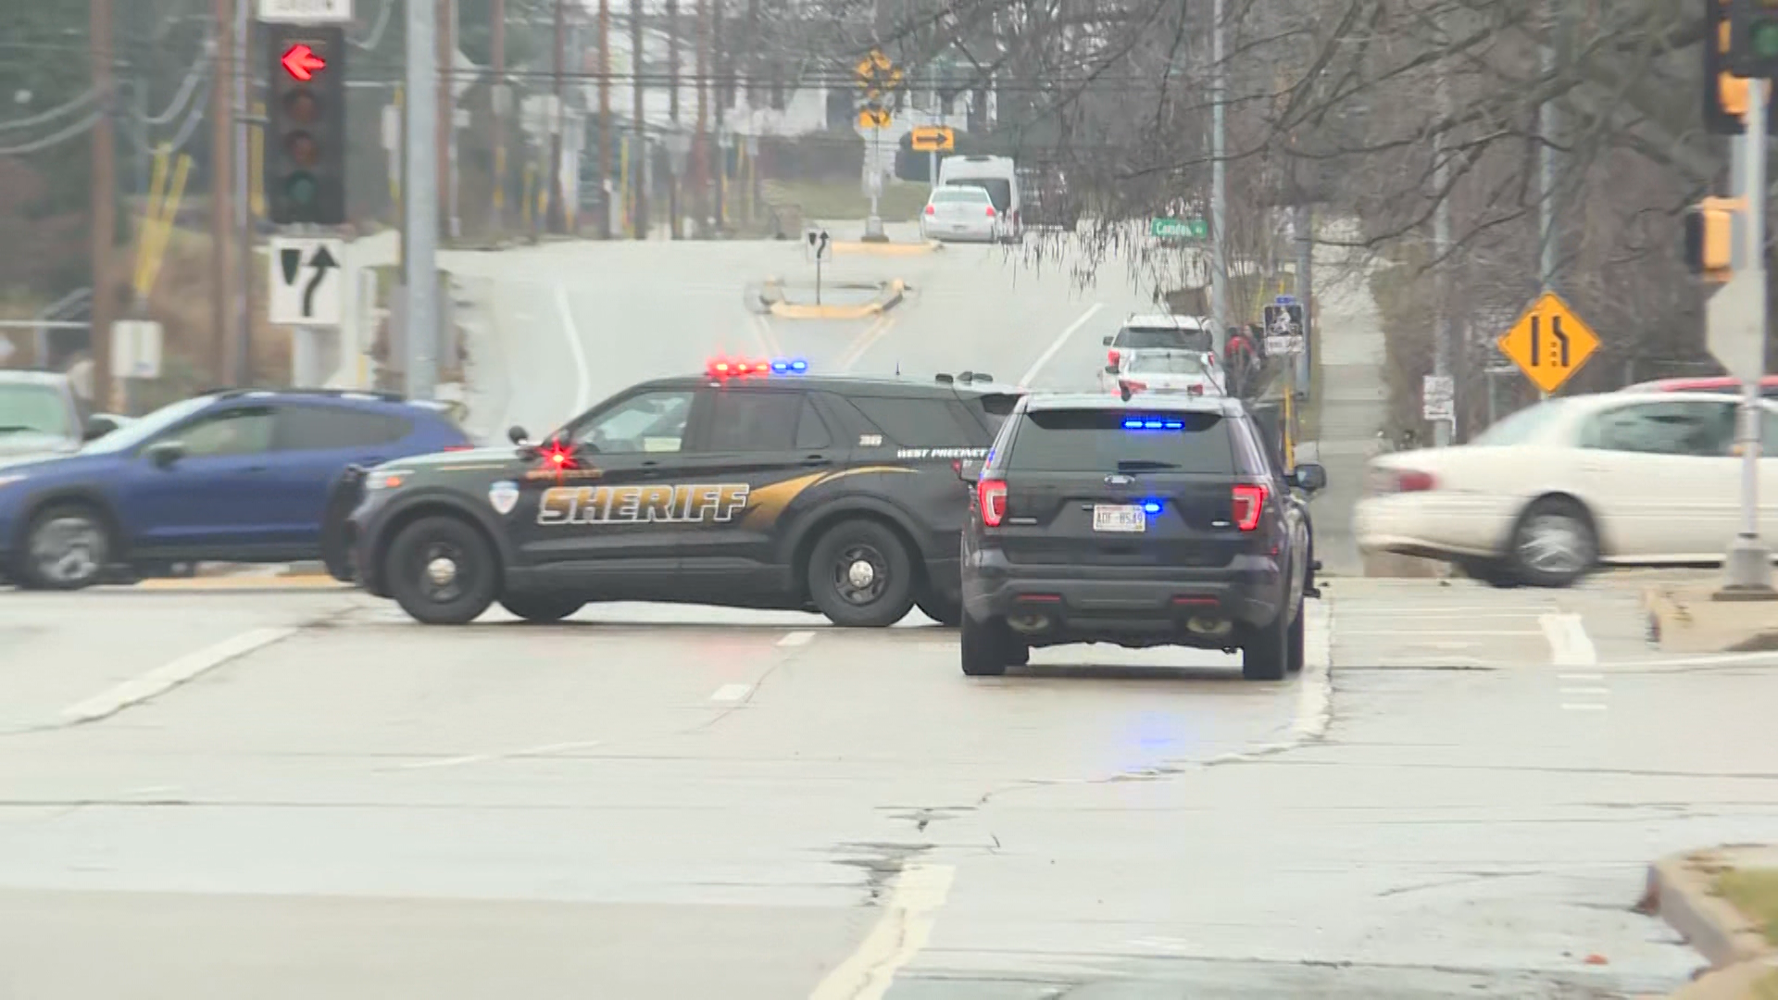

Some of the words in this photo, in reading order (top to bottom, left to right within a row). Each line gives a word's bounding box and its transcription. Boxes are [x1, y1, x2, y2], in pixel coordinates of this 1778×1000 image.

[897, 449, 930, 458] WEST
[931, 448, 988, 458] PRECINCT
[539, 483, 750, 524] SHERIFF
